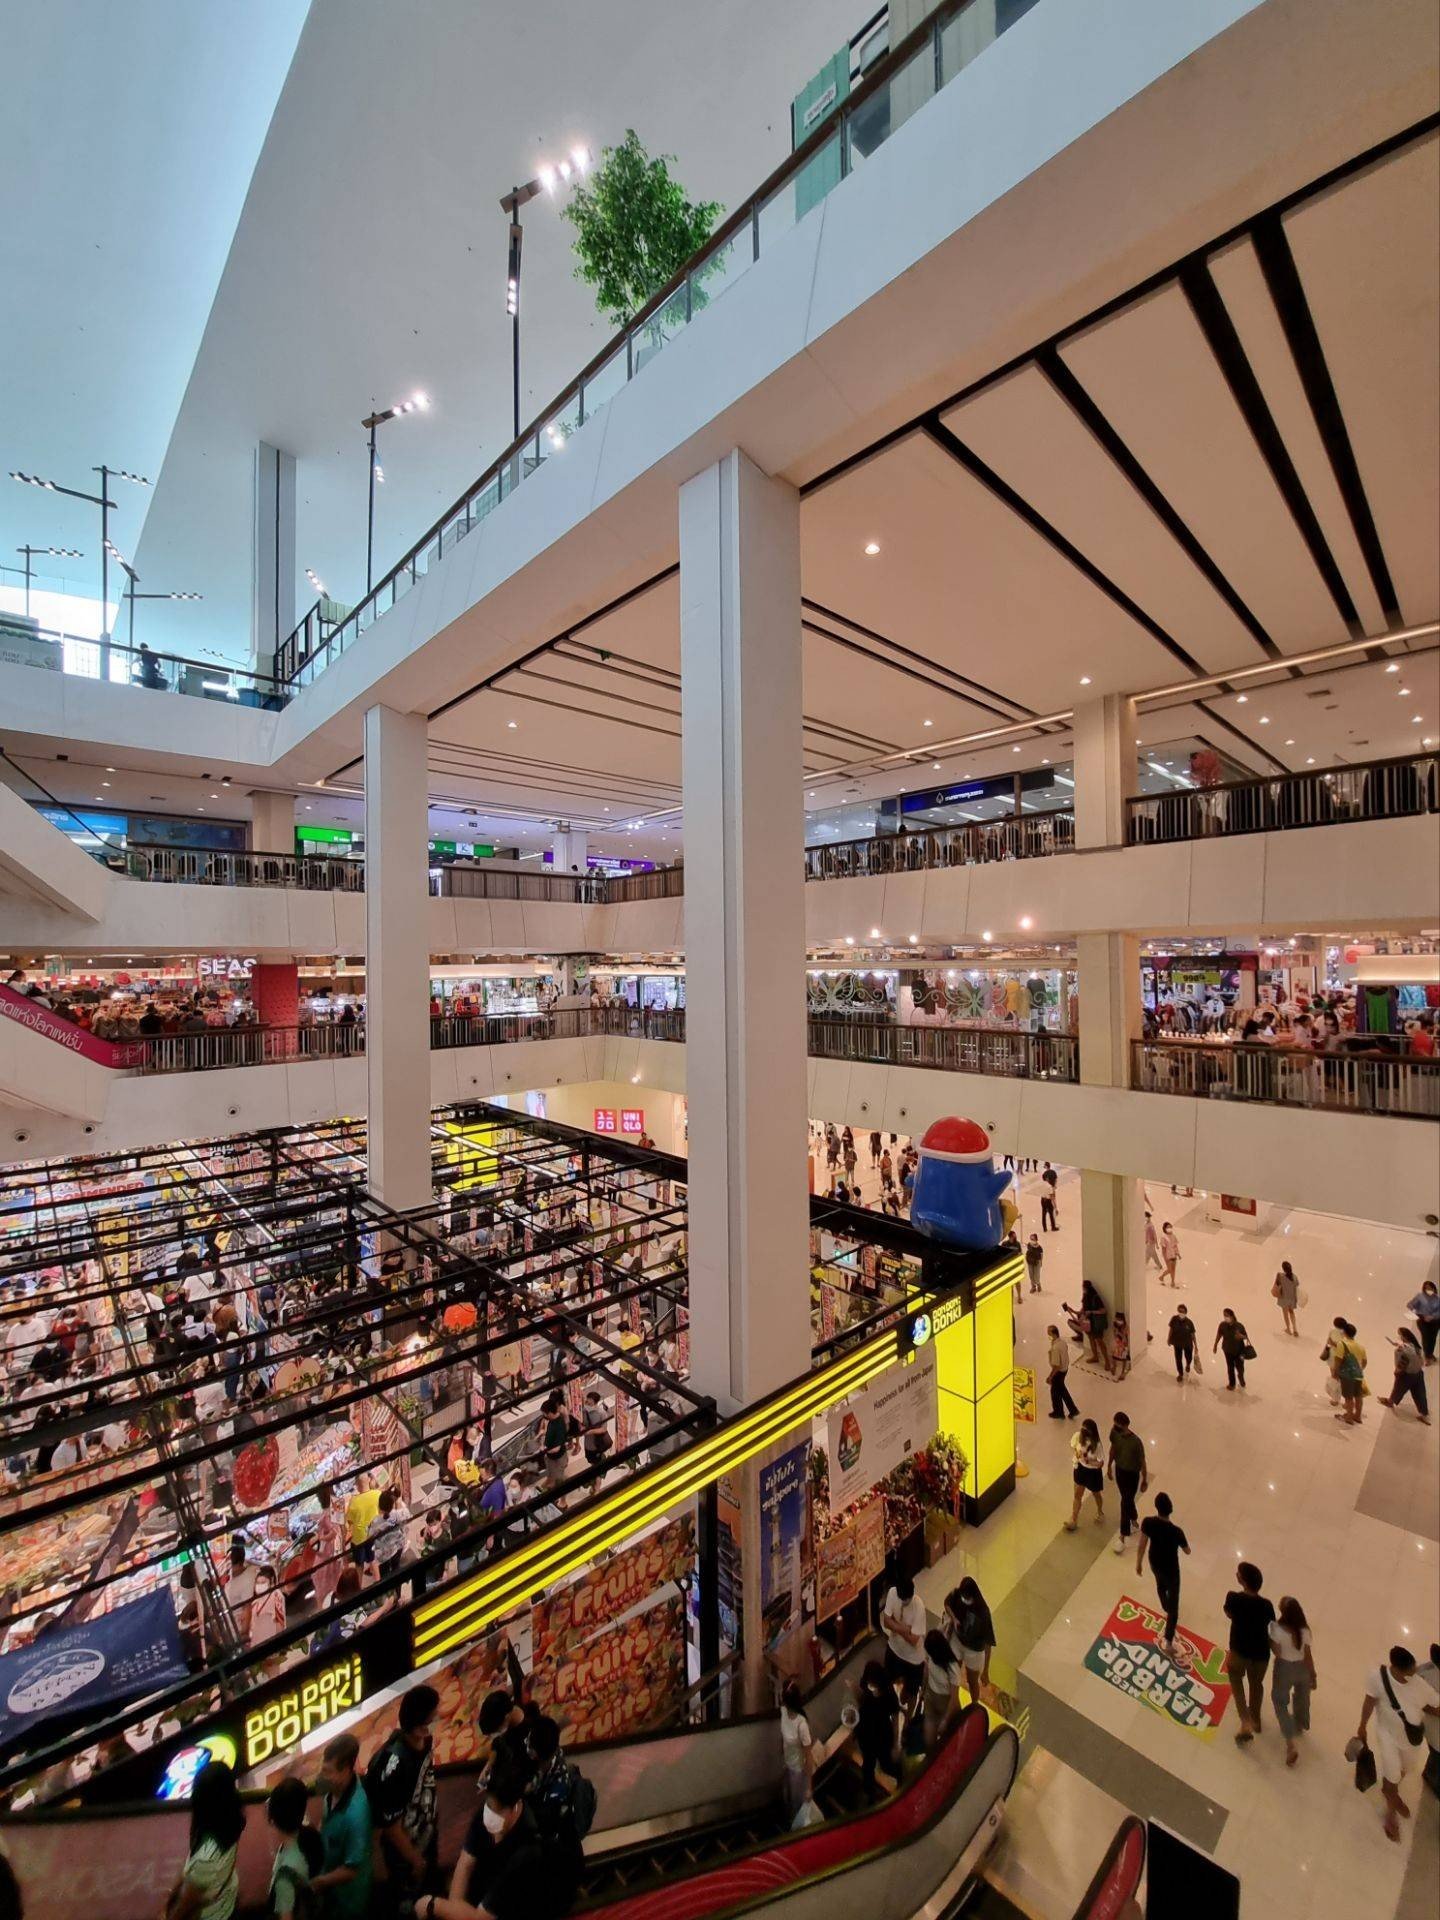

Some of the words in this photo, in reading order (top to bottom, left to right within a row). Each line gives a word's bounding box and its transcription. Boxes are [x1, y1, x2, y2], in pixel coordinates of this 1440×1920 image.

[623, 1112, 640, 1121] UNI
[623, 1121, 642, 1132] QLO
[573, 1547, 663, 1623] Fruits
[557, 1630, 650, 1699] Fruits
[1097, 1640, 1213, 1733] HARBOR
[1113, 1635, 1215, 1706] LAND
[246, 1693, 299, 1739] DON
[303, 1662, 352, 1708] DON
[558, 1688, 651, 1746] Fruits
